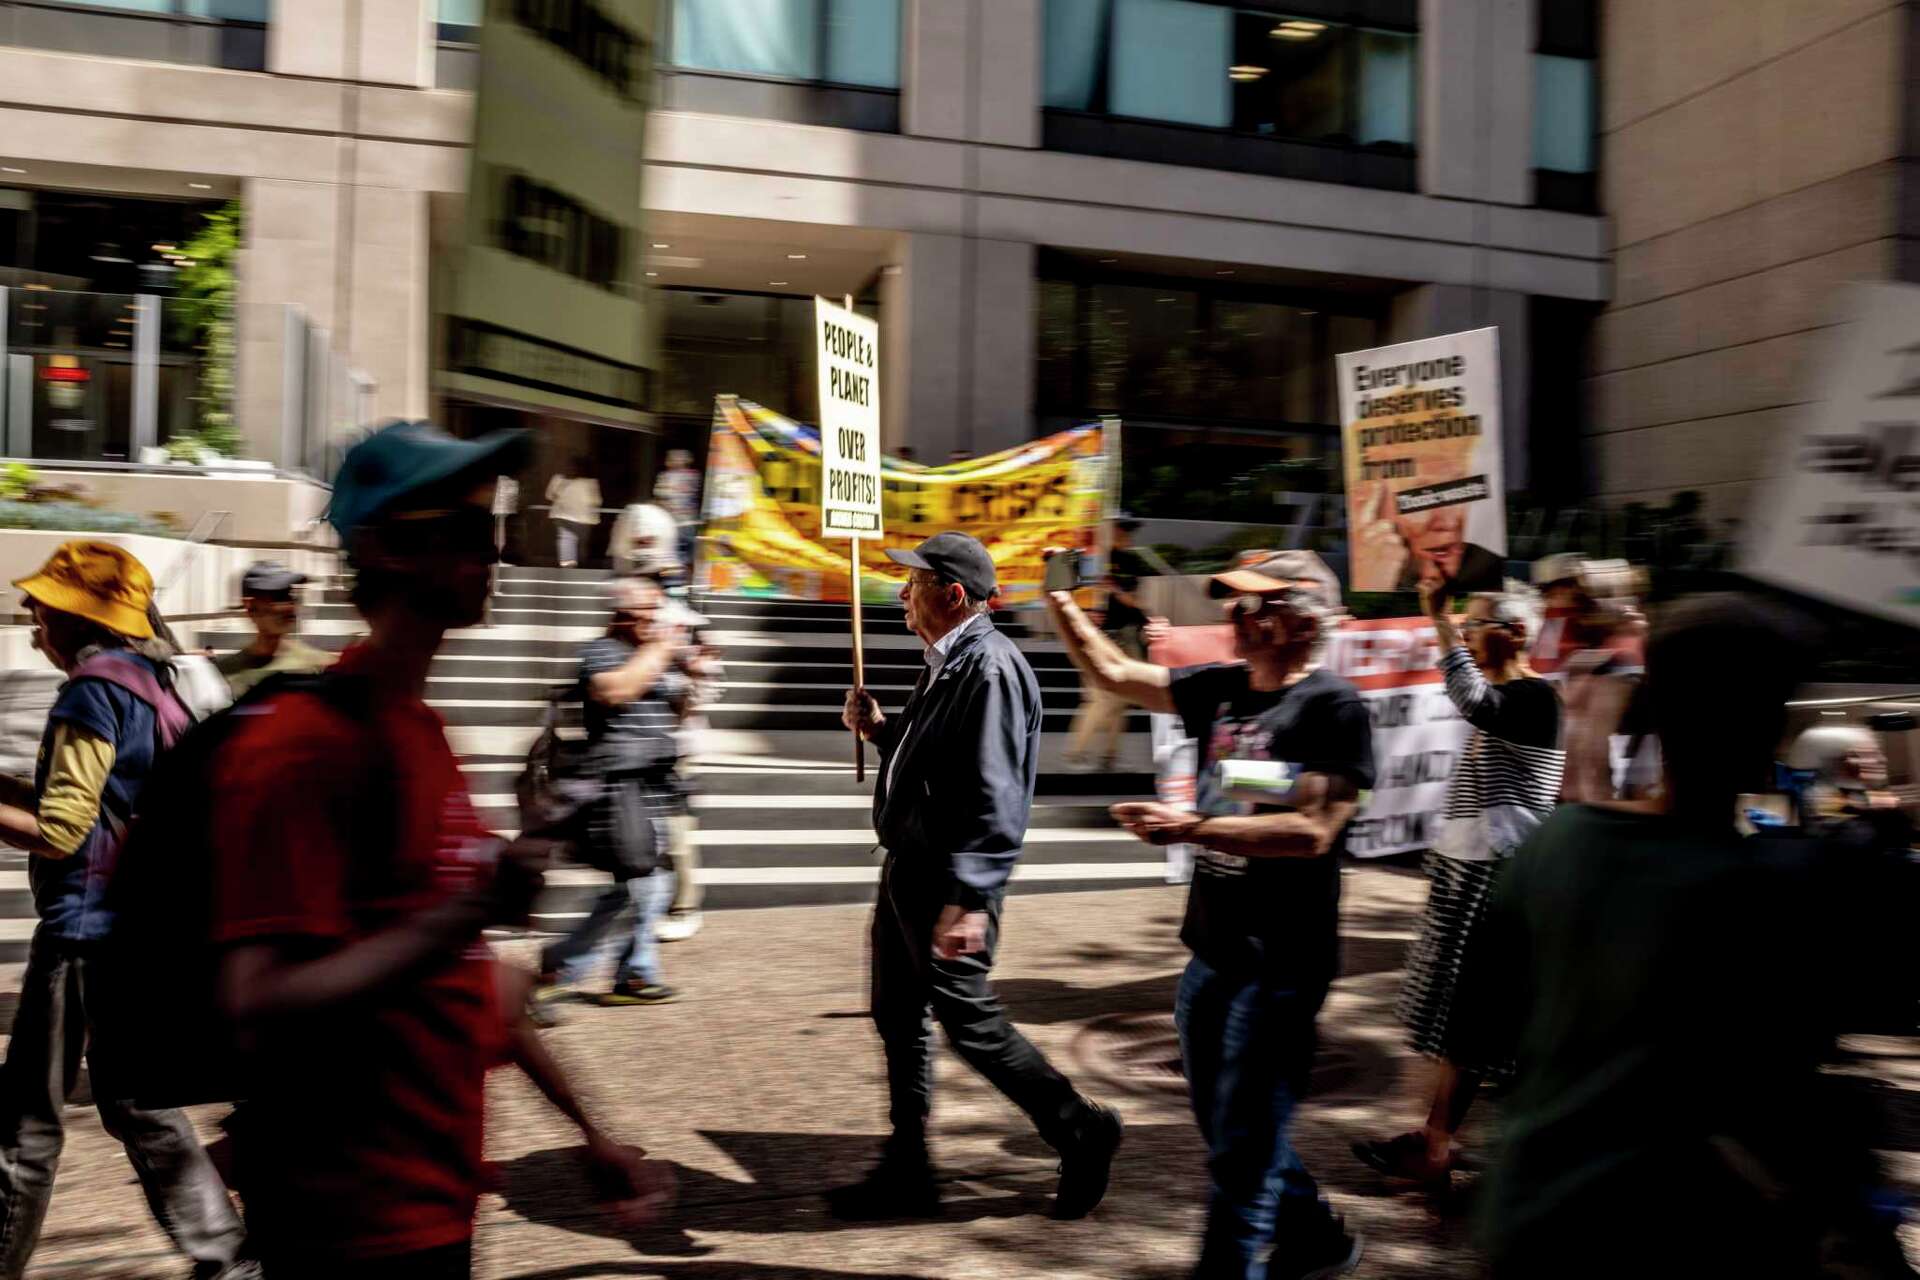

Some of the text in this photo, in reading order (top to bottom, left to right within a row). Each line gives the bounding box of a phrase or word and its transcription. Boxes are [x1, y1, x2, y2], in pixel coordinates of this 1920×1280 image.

[824, 321, 873, 367] PEOPLE &
[830, 366, 869, 407] PLANET
[1355, 355, 1465, 390] Everyone
[838, 427, 865, 462] OVER
[829, 468, 876, 504] PROFITS!
